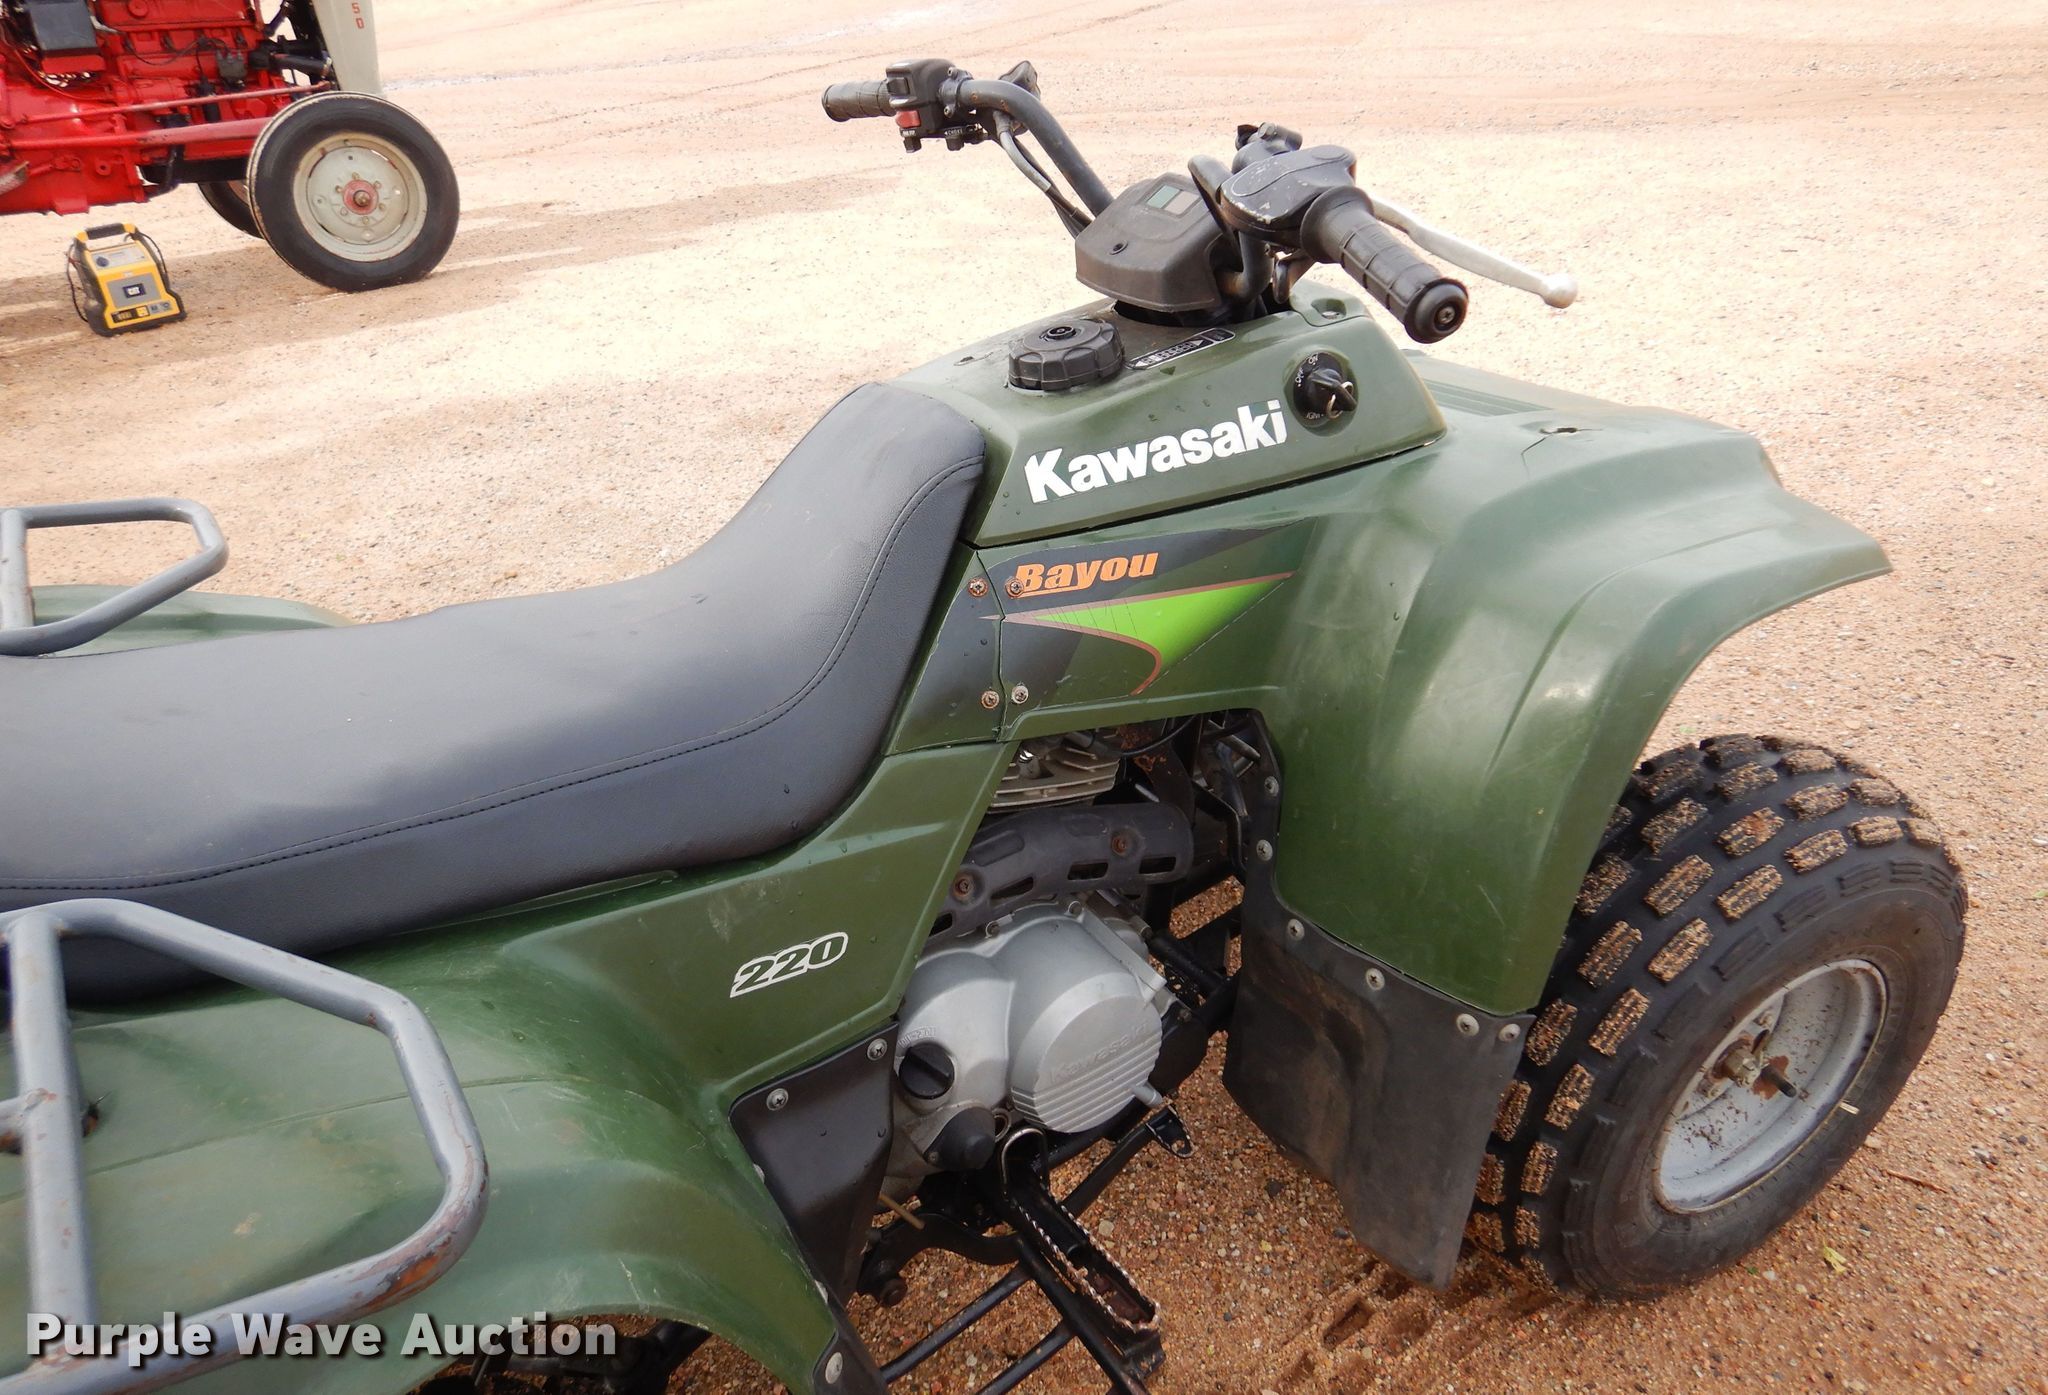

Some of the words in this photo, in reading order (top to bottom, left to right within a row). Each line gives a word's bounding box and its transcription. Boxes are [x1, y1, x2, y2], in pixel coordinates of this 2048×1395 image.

[1025, 400, 1287, 503] Kawasaki
[1014, 552, 1159, 598] Bayou
[730, 932, 849, 998] 220
